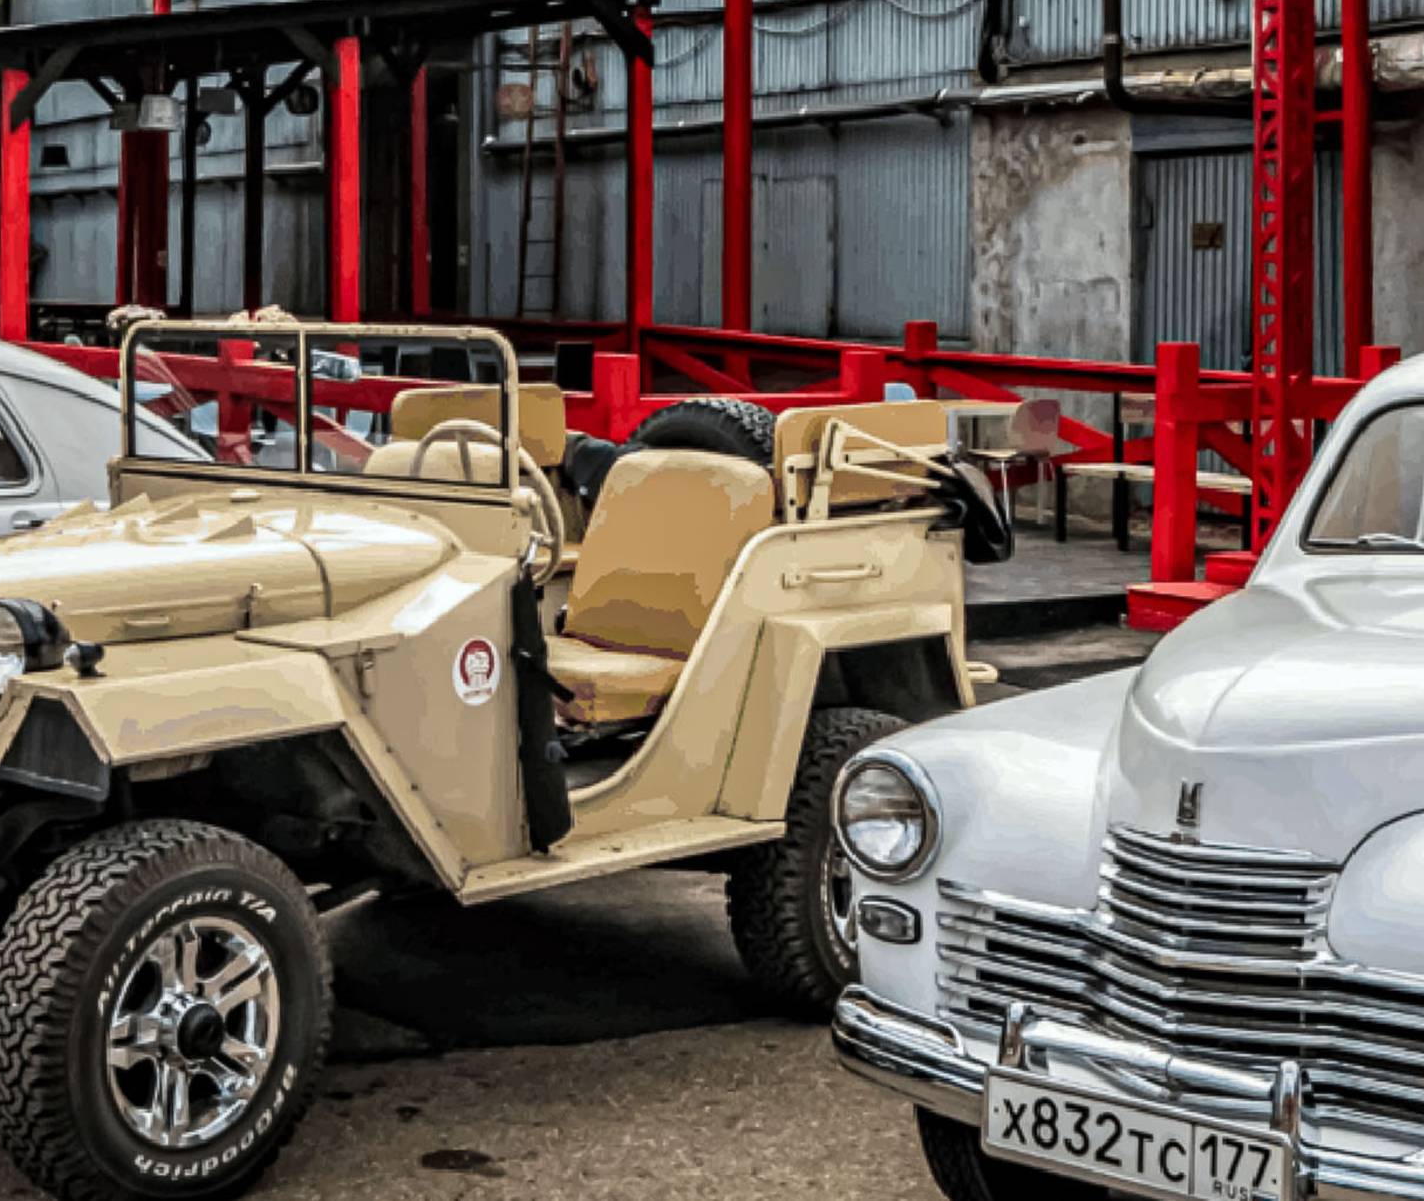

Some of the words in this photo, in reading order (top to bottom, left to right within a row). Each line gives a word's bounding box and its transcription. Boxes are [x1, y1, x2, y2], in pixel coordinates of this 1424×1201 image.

[1002, 1097, 1186, 1182] Х832ТС
[1200, 1134, 1271, 1187] 177
[1213, 1180, 1249, 1201] RUS
